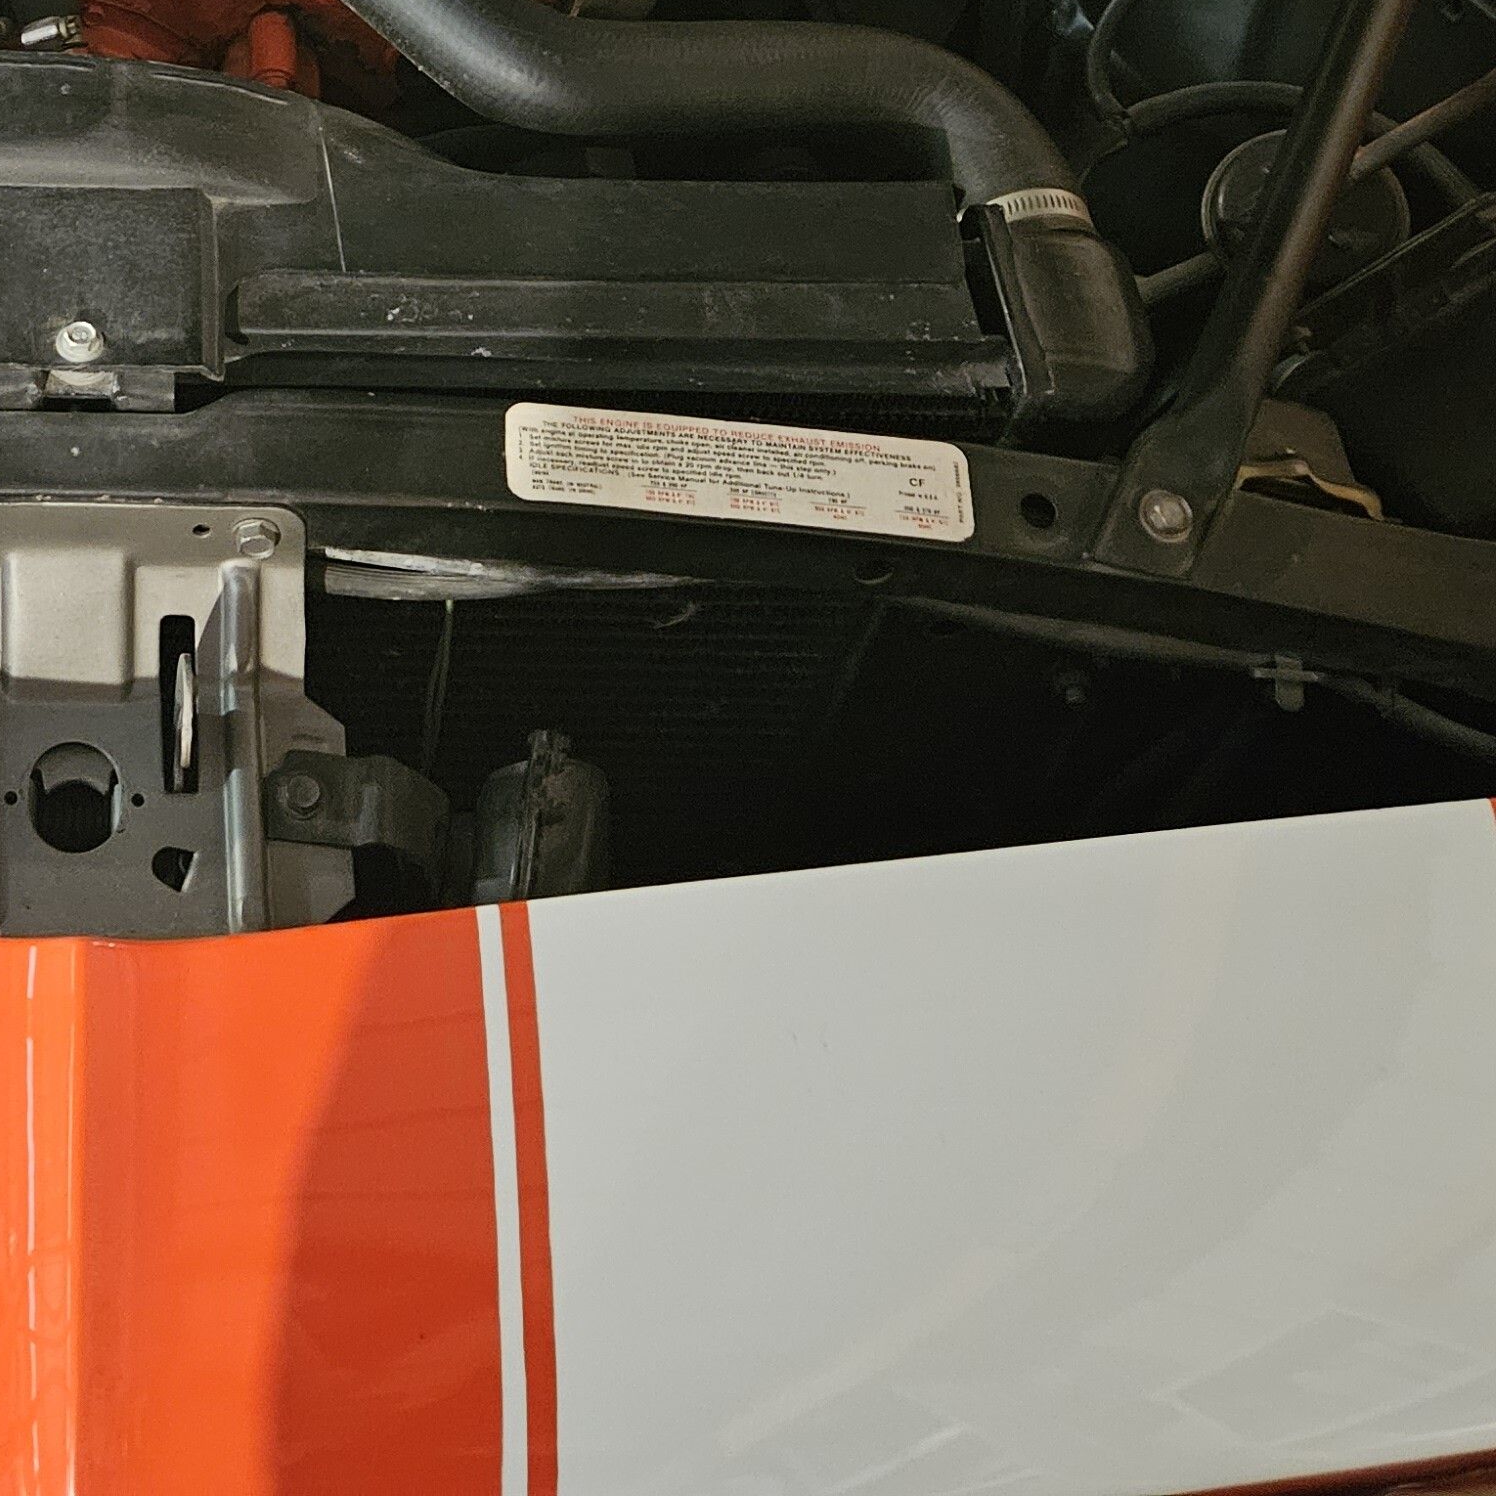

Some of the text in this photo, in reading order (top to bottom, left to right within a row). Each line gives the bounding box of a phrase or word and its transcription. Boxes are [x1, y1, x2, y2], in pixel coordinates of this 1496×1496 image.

[561, 422, 610, 432] FOLLOWING
[614, 426, 675, 438] ADJUSTMENTS
[697, 434, 747, 444] NECESSARY
[765, 441, 806, 450] MAINTAIN
[808, 445, 841, 454] SYSTEM
[844, 449, 911, 461] EFFECTIVENESS
[572, 415, 596, 423] THIS
[599, 417, 637, 427] ENGINE
[656, 422, 708, 434] EQUIPPED
[730, 430, 773, 441] REDUCE
[777, 435, 825, 445] EXHAUST
[829, 440, 880, 451] EMISSION
